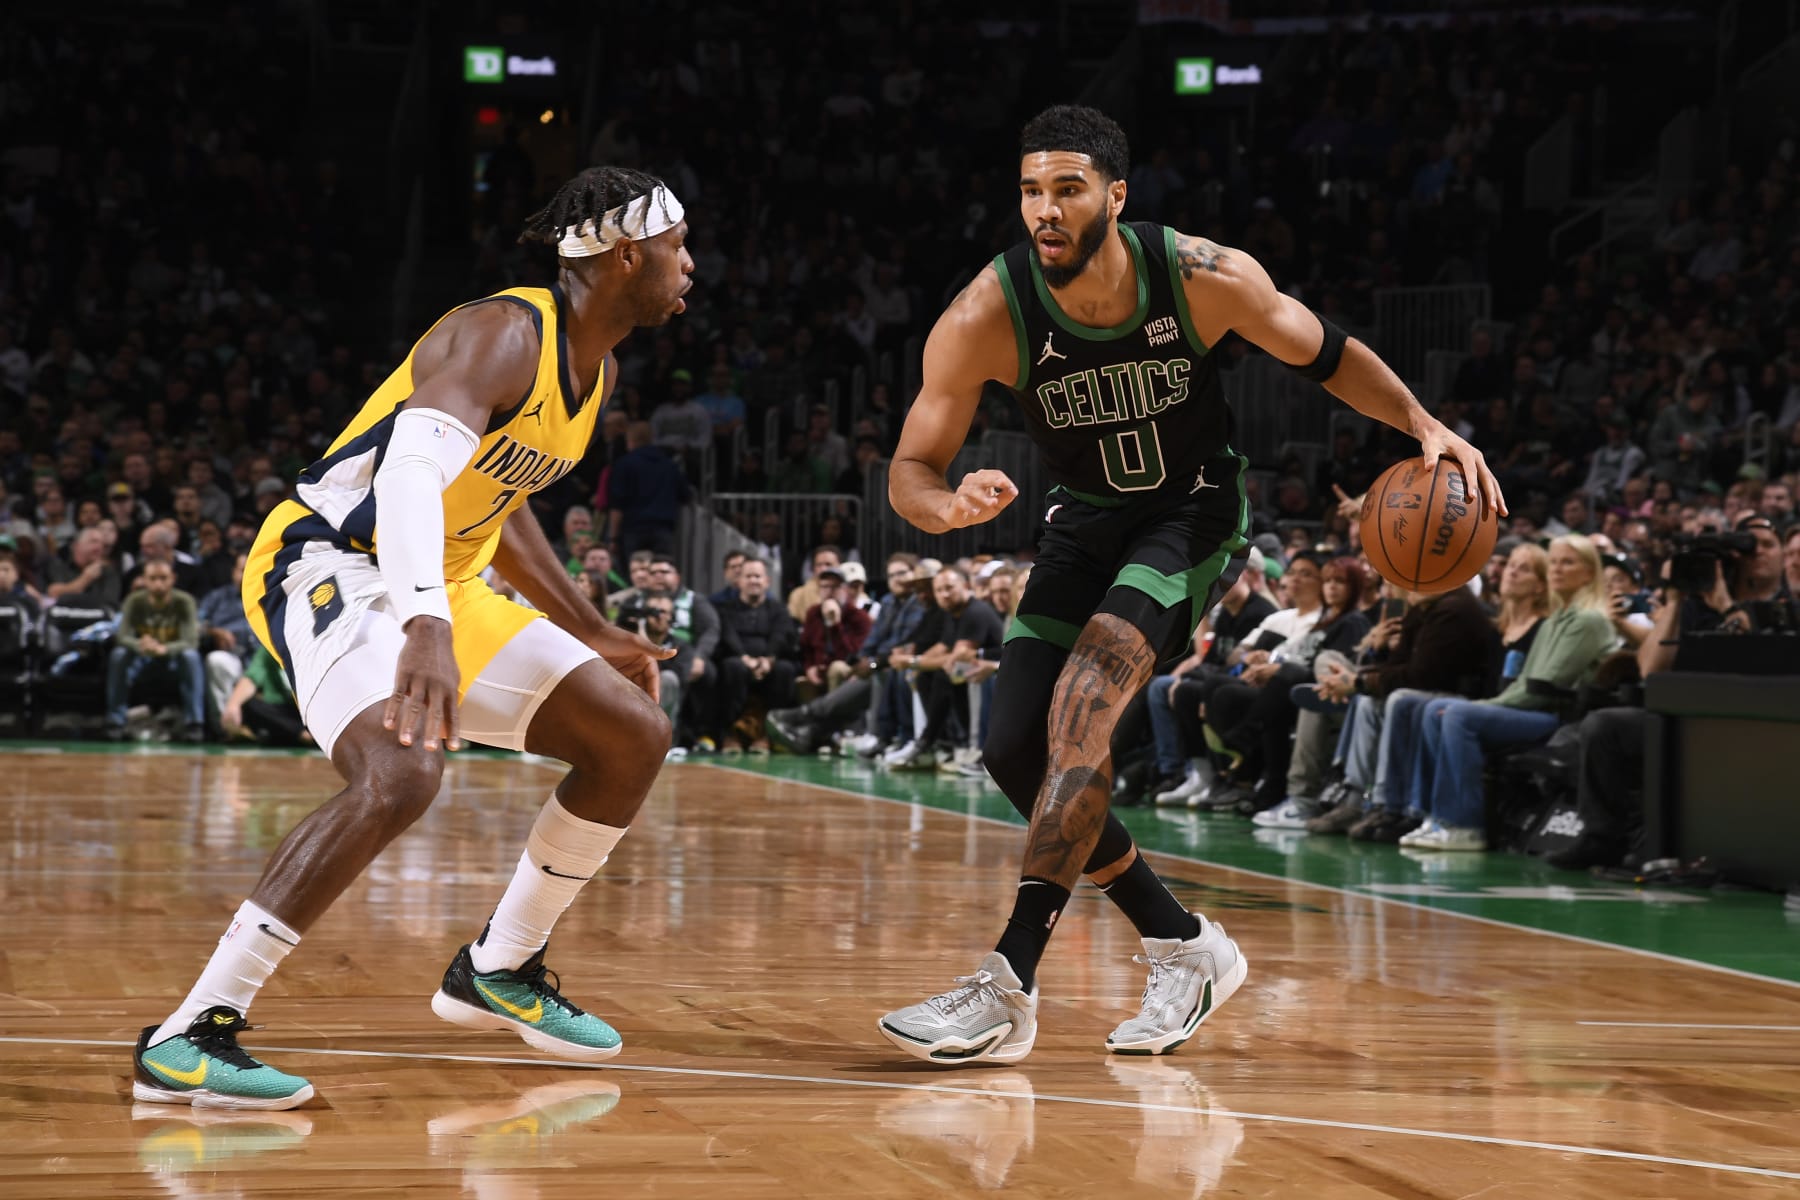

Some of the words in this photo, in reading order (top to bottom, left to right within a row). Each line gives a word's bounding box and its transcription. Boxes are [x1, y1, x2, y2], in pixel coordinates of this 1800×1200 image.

[467, 51, 501, 76] TD
[1178, 63, 1210, 88] TD
[1144, 315, 1178, 337] VISTA
[1148, 328, 1179, 348] PRINT
[1036, 358, 1191, 429] CELTICS
[472, 432, 575, 492] INDIAN
[1098, 421, 1167, 492] 0
[455, 488, 519, 537] 7
